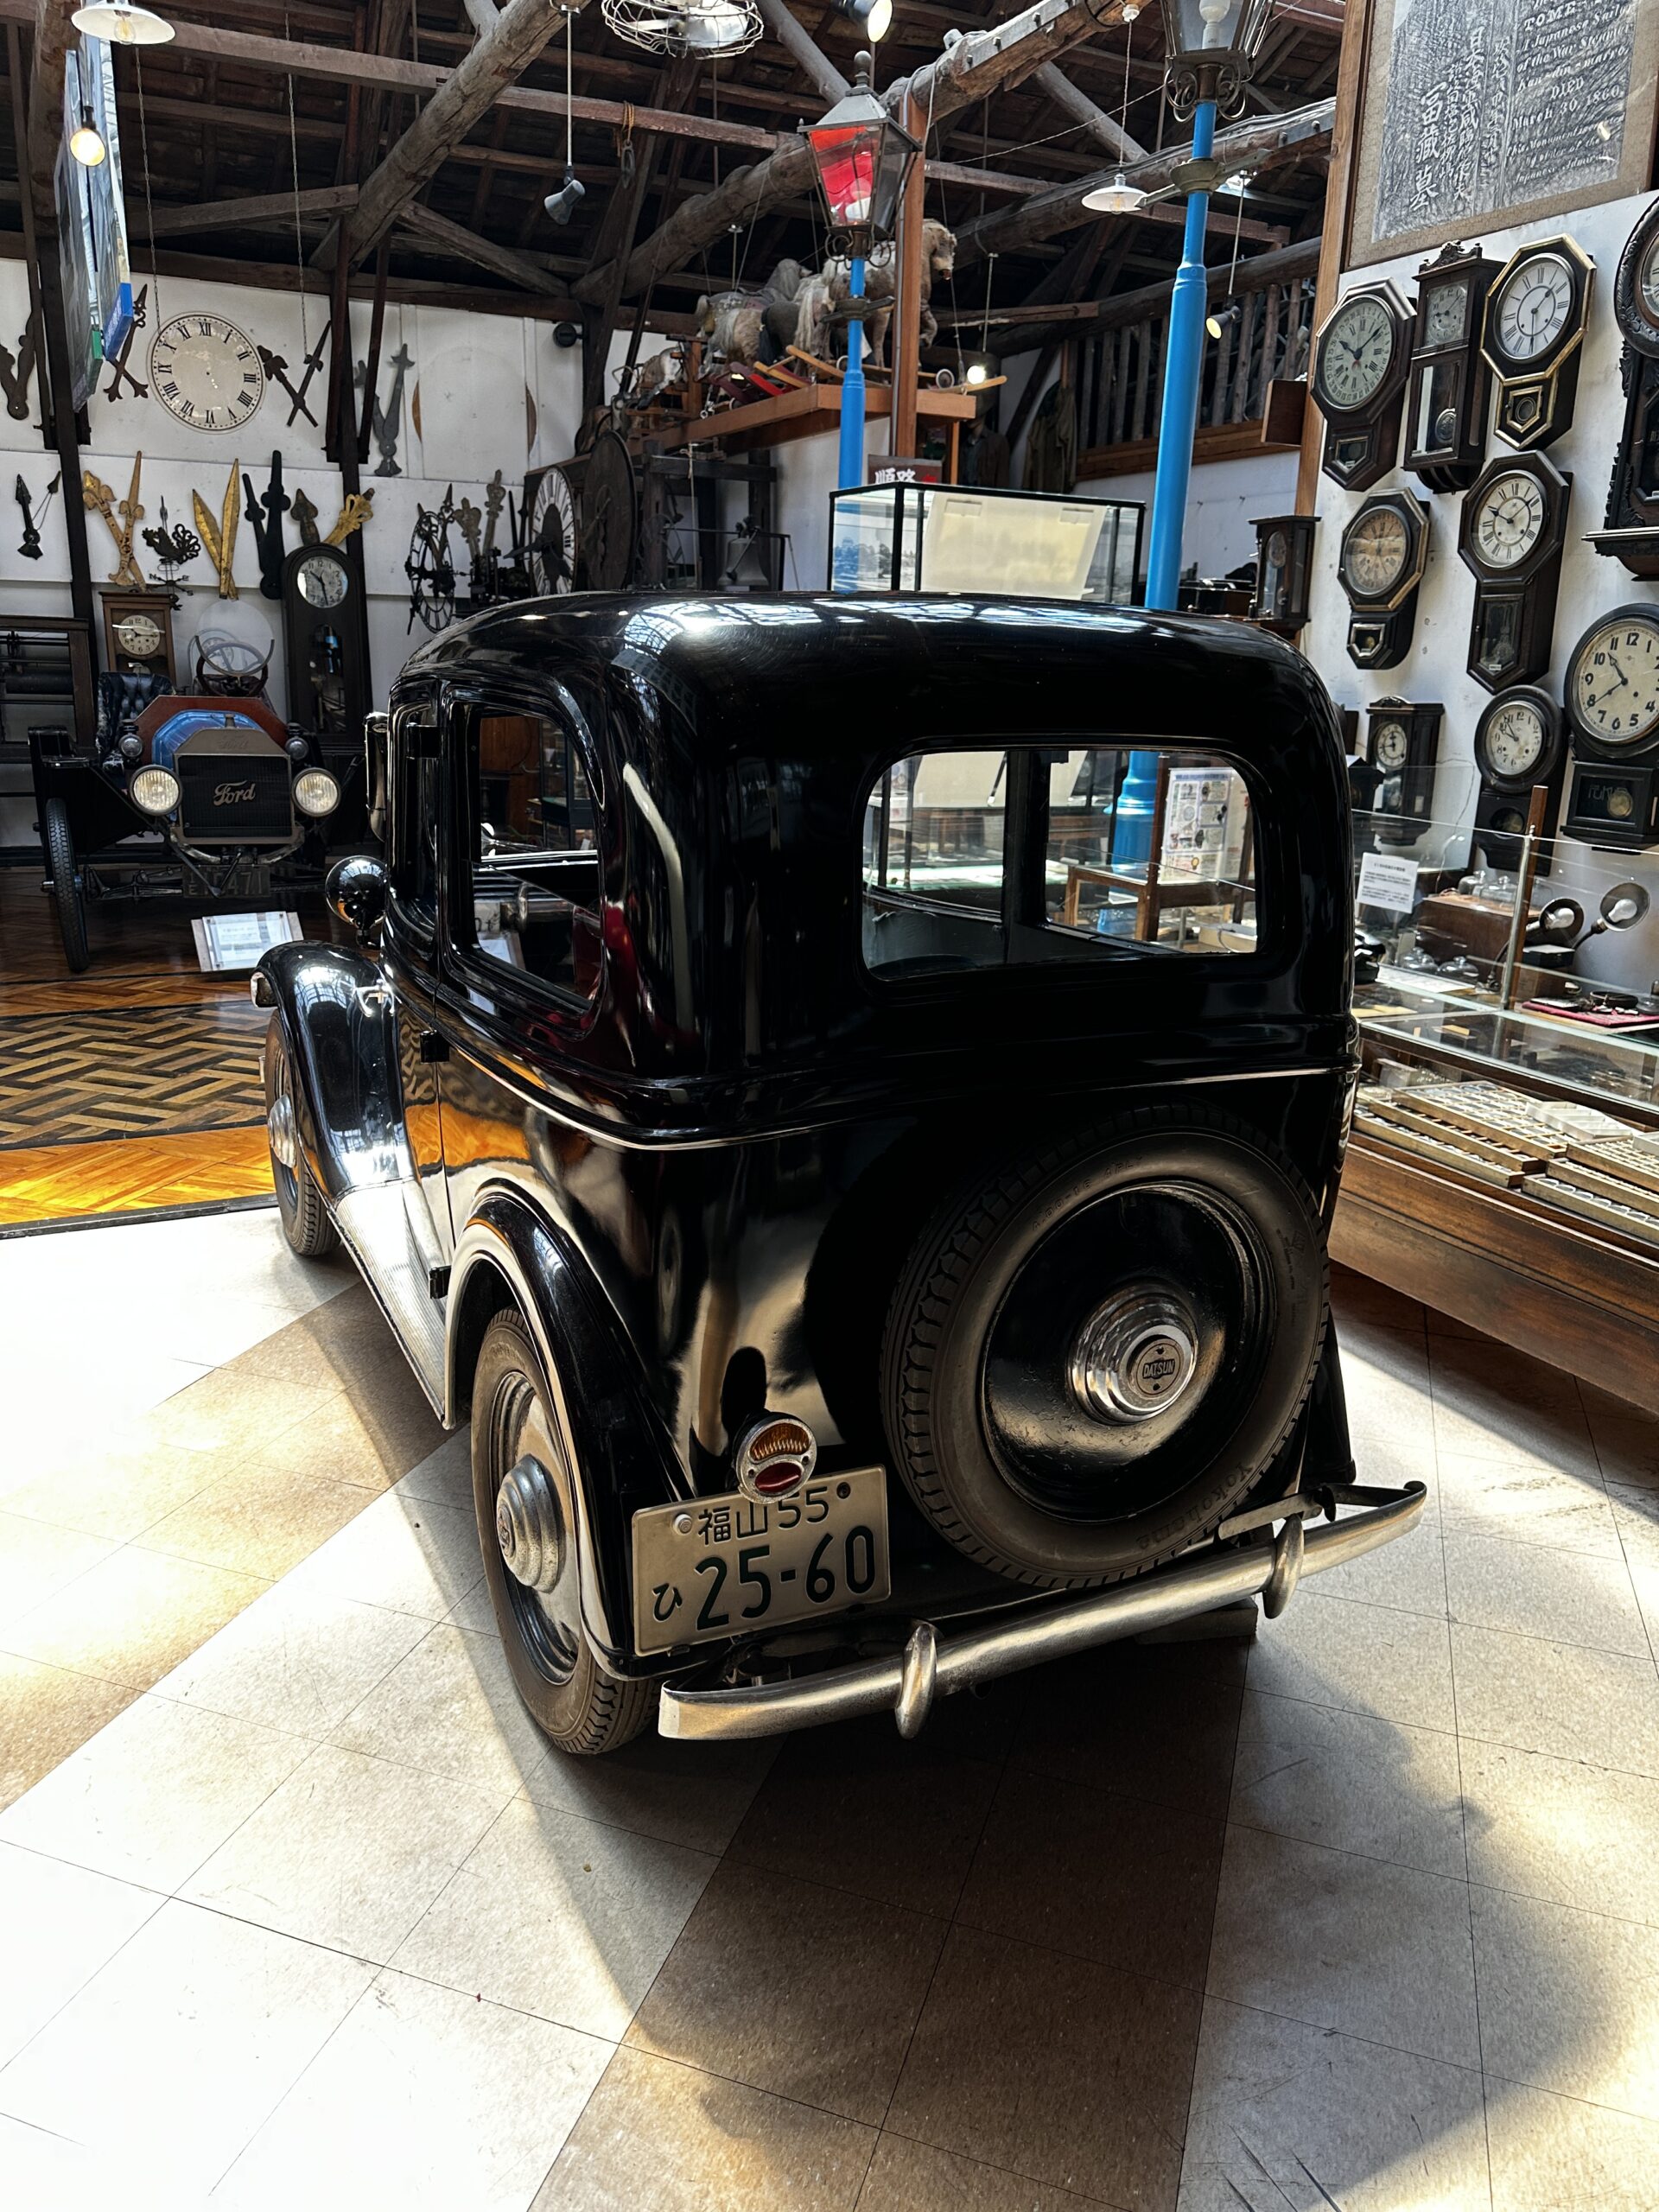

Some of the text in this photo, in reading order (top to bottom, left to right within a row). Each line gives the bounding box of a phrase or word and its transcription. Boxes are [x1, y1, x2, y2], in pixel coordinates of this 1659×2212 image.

[1550, 77, 1585, 99] DIED
[213, 780, 256, 806] Ford
[1142, 1358, 1175, 1379] DATSUN
[652, 1525, 875, 1631] ひ 25-60
